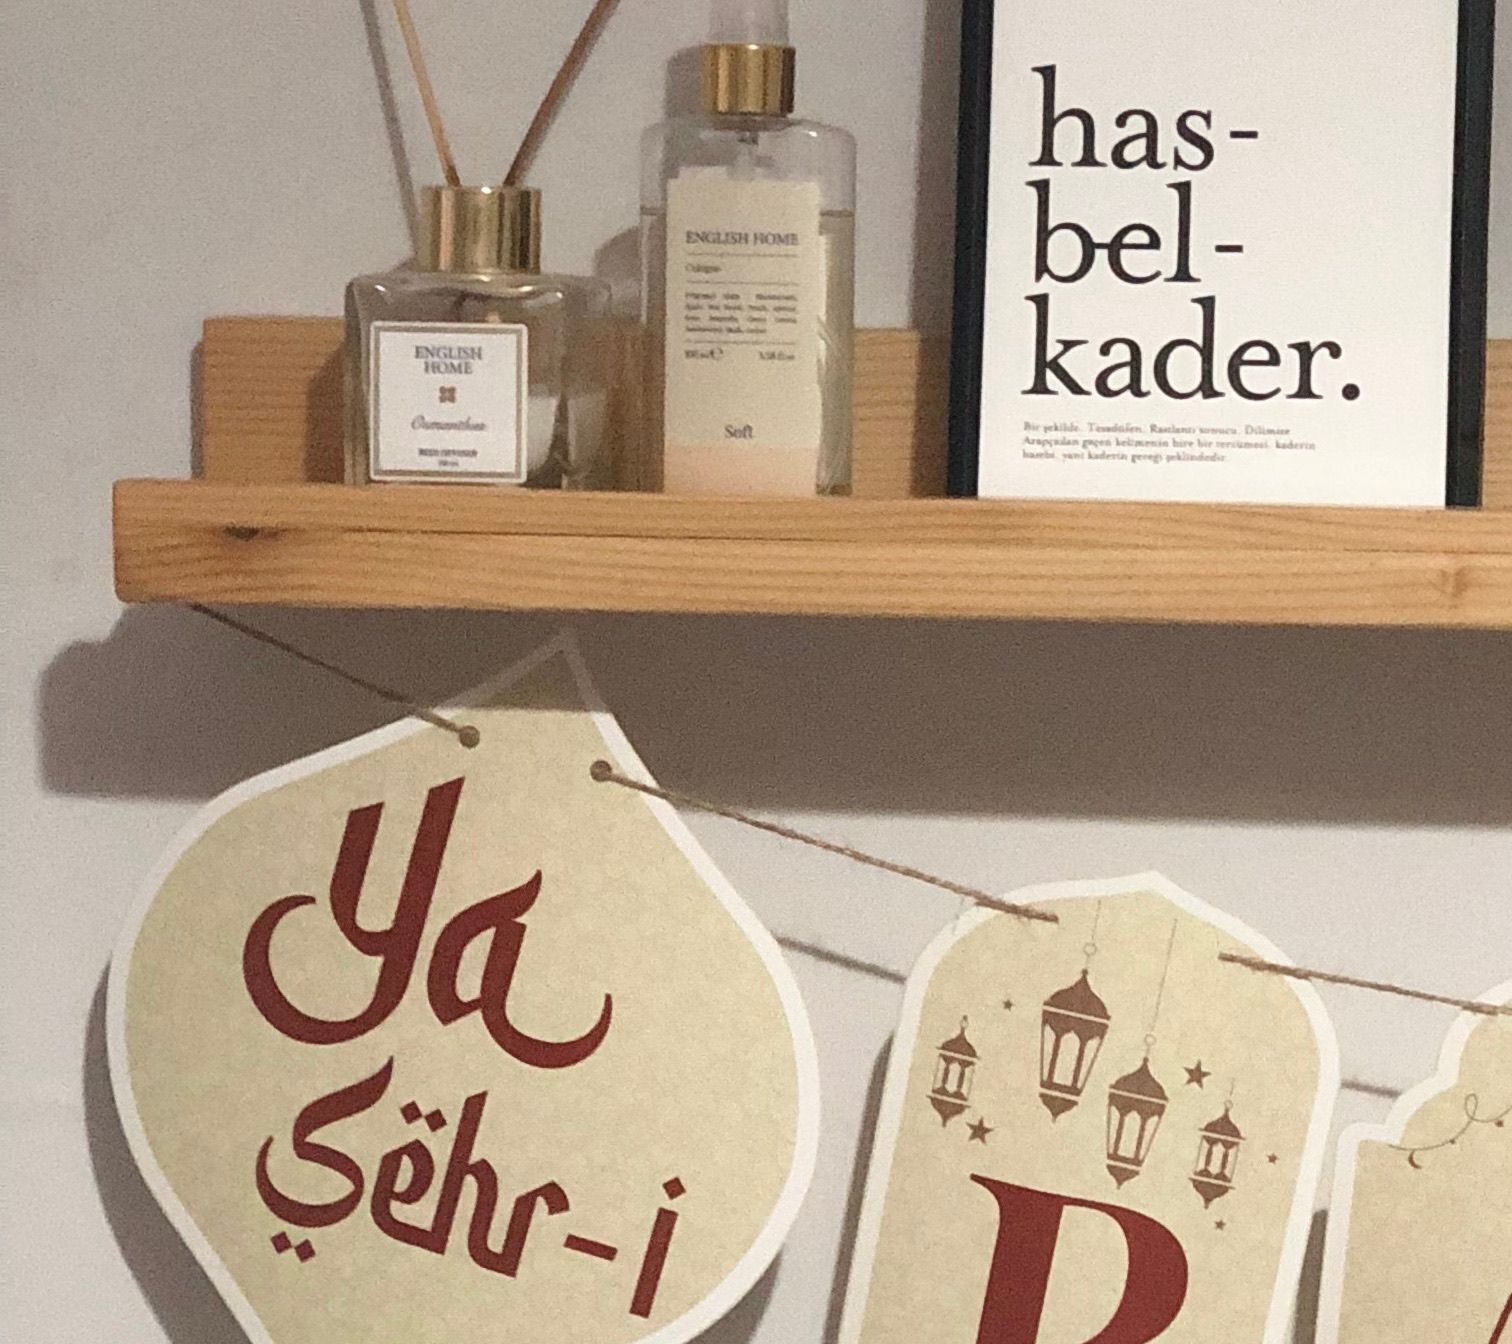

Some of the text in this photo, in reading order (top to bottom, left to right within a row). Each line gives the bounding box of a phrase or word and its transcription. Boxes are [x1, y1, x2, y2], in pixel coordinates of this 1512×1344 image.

[1028, 64, 1259, 172] has-
[684, 229, 799, 247] ENGLISH HOME
[1025, 178, 1244, 285] bel-
[414, 344, 483, 361] ENGLISH
[423, 360, 474, 375] HOME
[1021, 292, 1360, 401] kader.
[724, 424, 755, 440] Soft
[246, 777, 612, 1069] Ya
